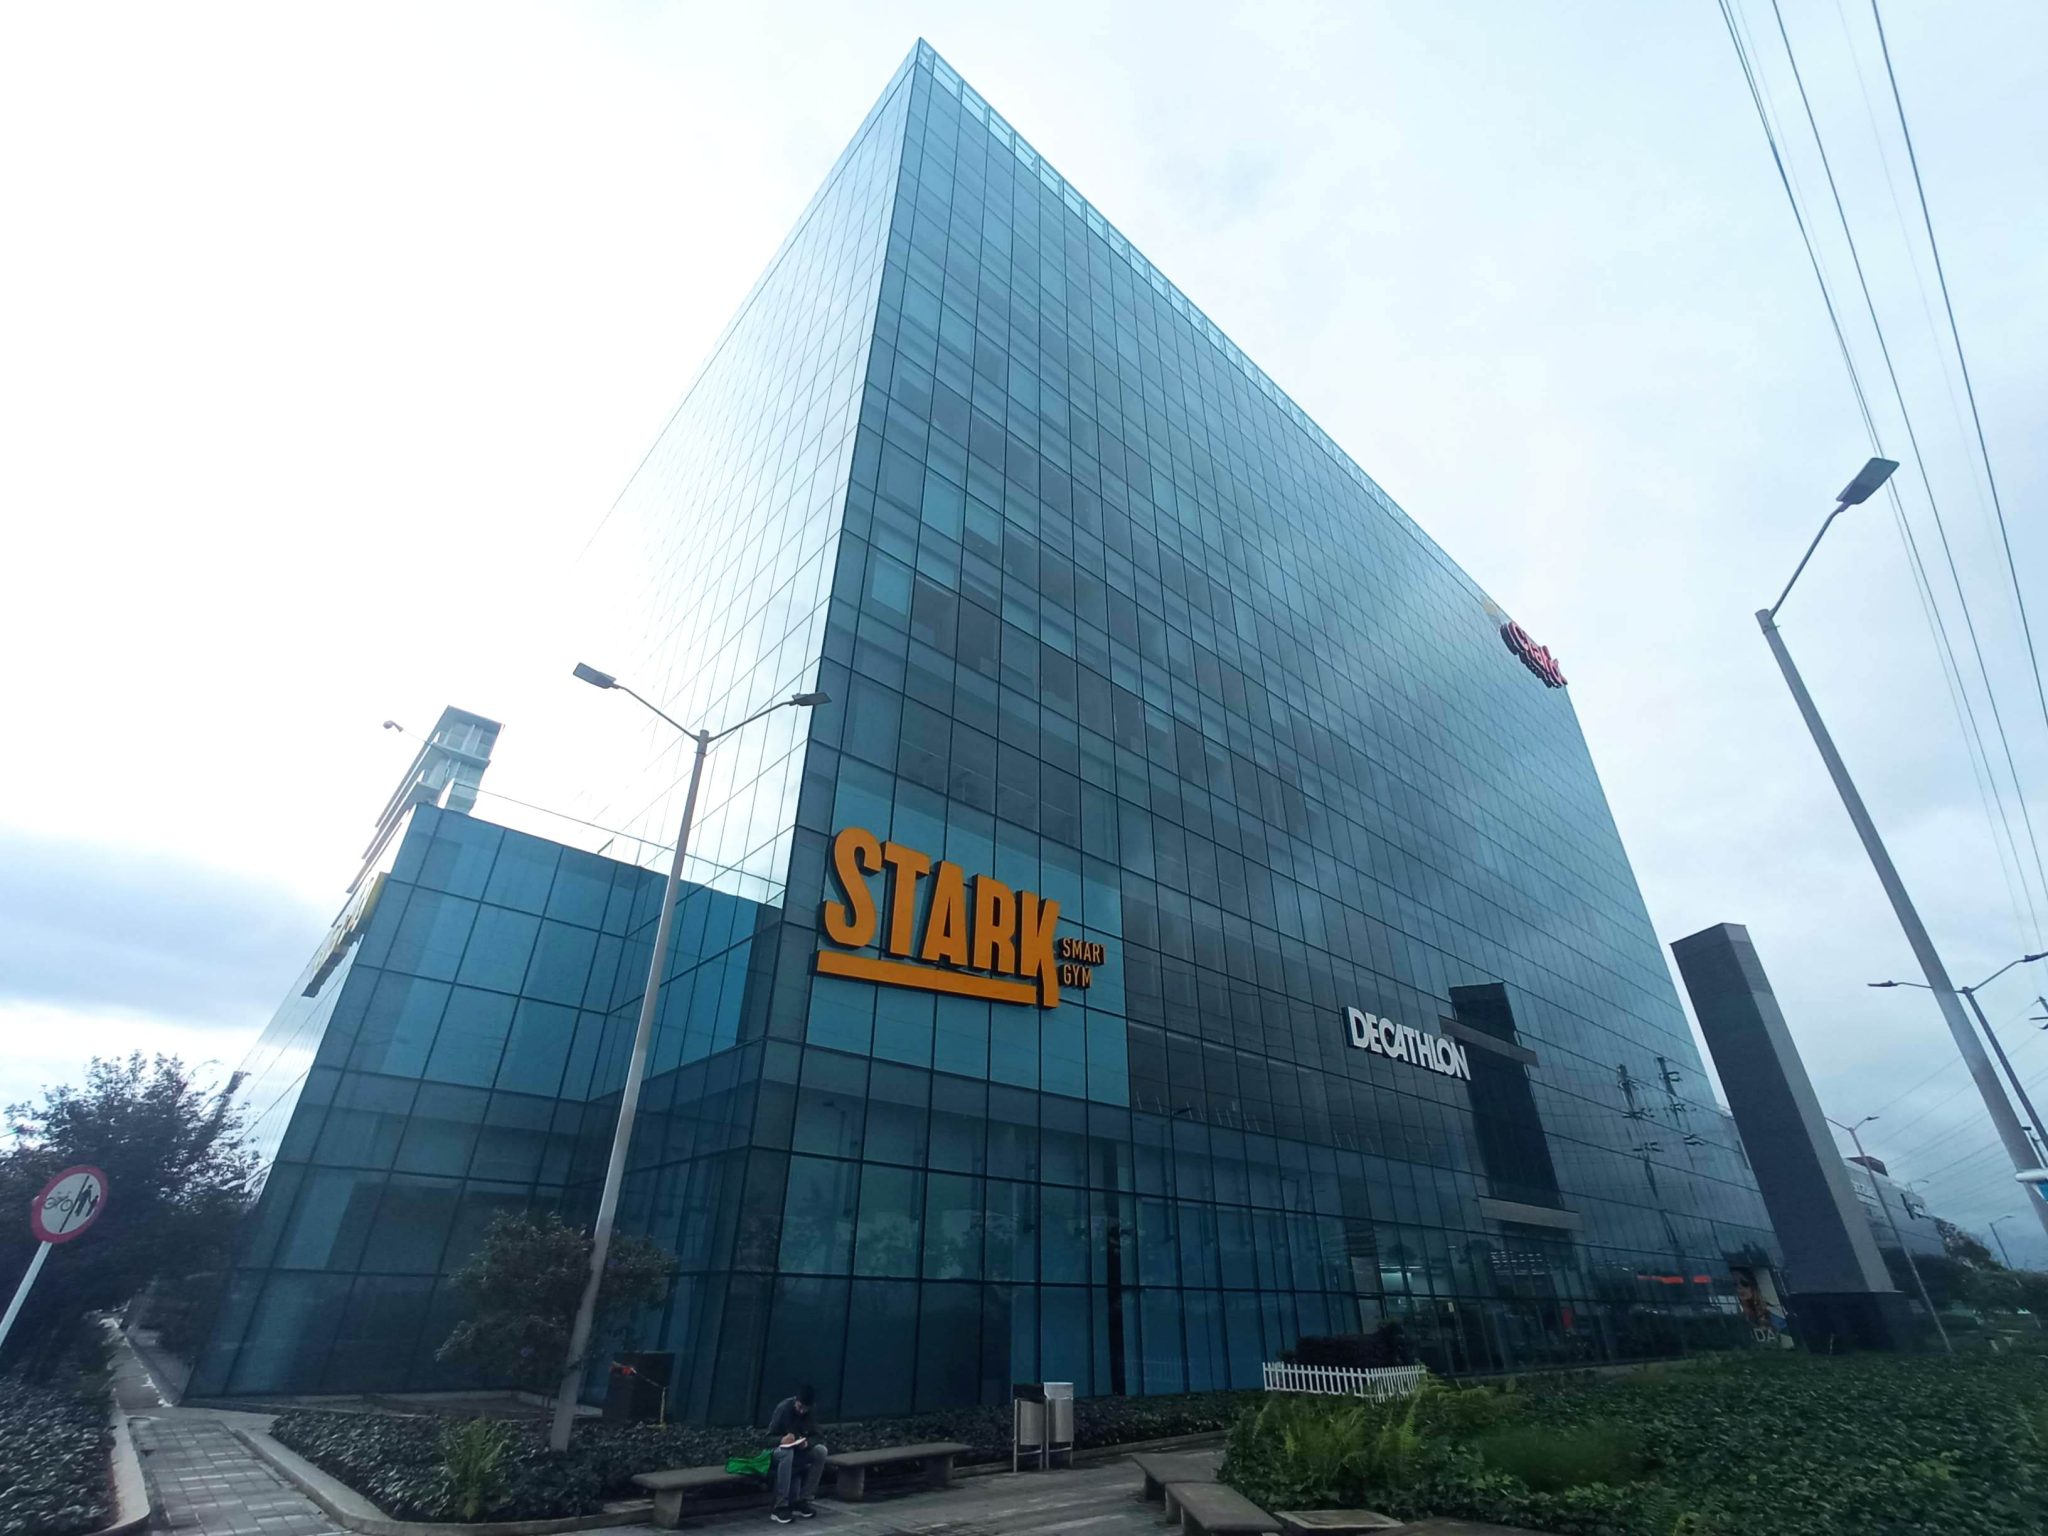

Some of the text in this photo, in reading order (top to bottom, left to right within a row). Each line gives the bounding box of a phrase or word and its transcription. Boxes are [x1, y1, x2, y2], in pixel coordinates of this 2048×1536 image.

[820, 827, 1060, 1008] STARK
[1061, 937, 1107, 965] SMART
[1062, 963, 1093, 988] GYM
[1346, 1006, 1471, 1081] DECATHLON
